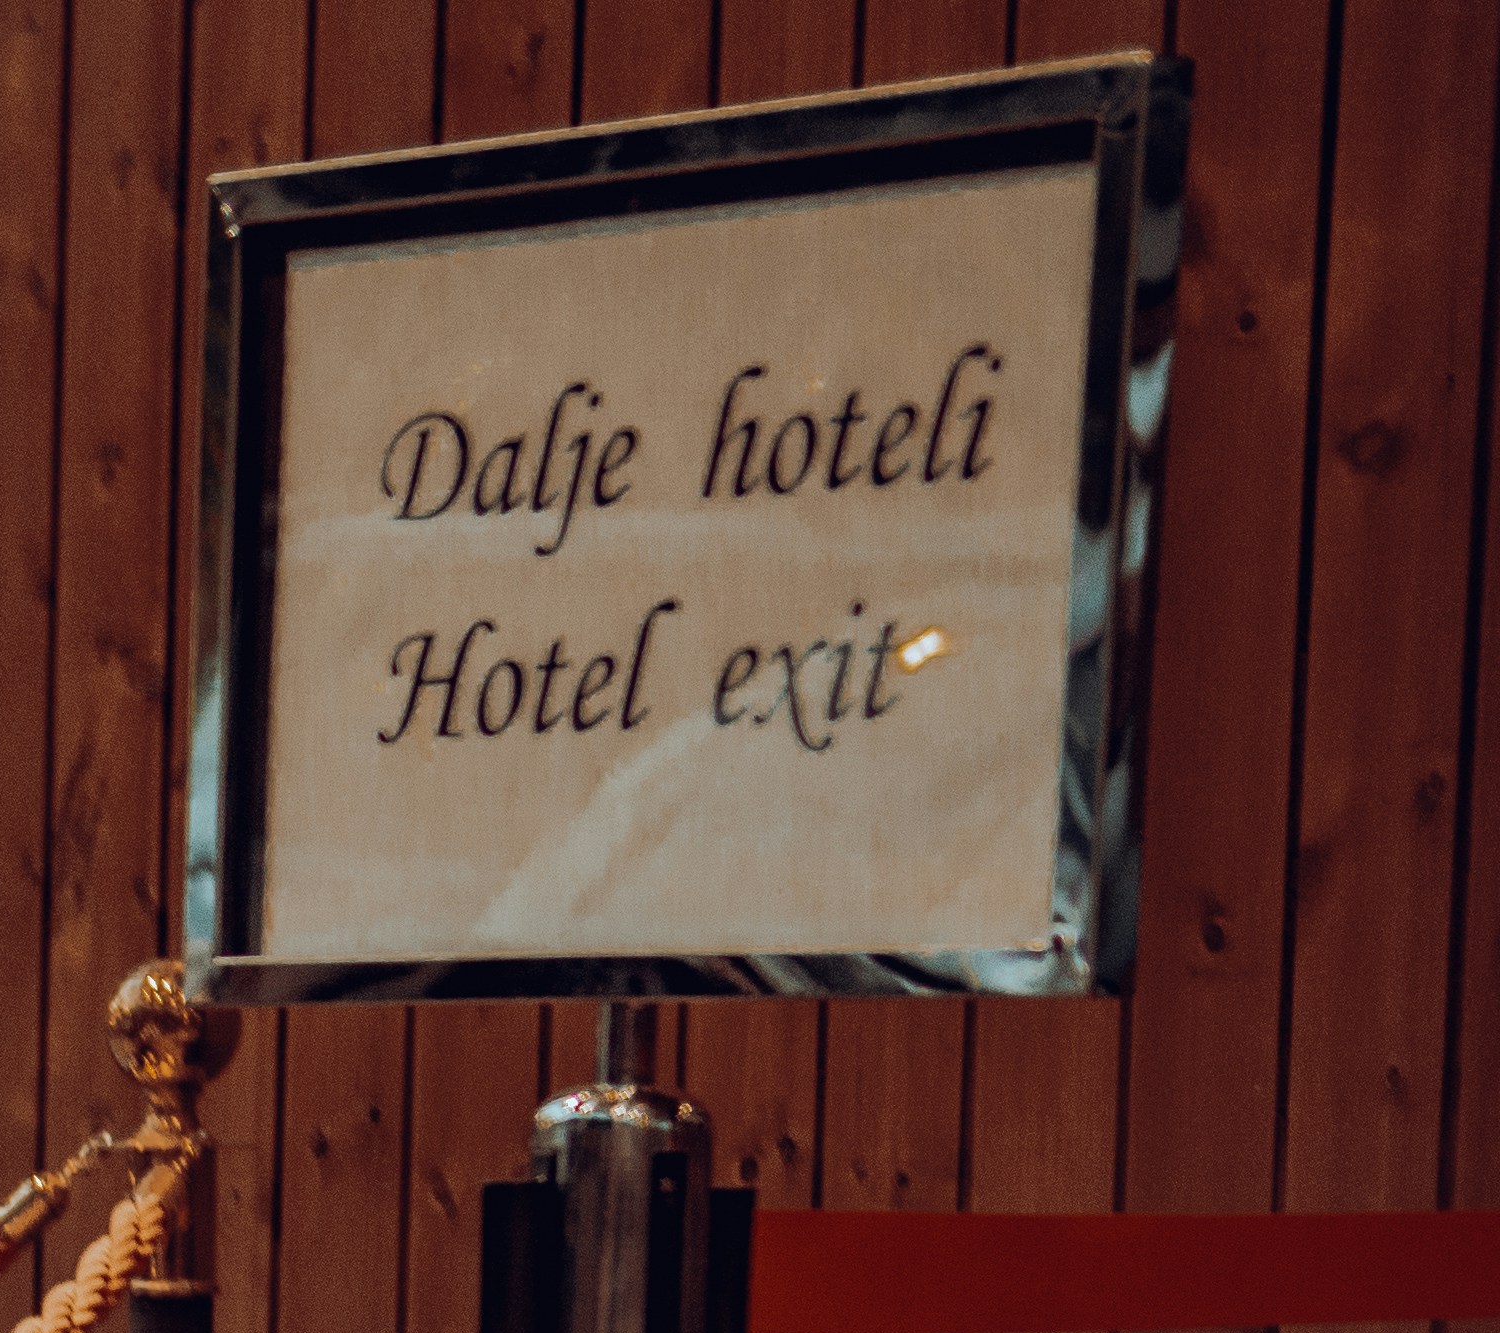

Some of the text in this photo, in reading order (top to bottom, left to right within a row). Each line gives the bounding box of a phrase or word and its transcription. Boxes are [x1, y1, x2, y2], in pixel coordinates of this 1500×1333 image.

[379, 342, 1004, 557] Dalje hoteli
[375, 596, 905, 753] Hotel exit
